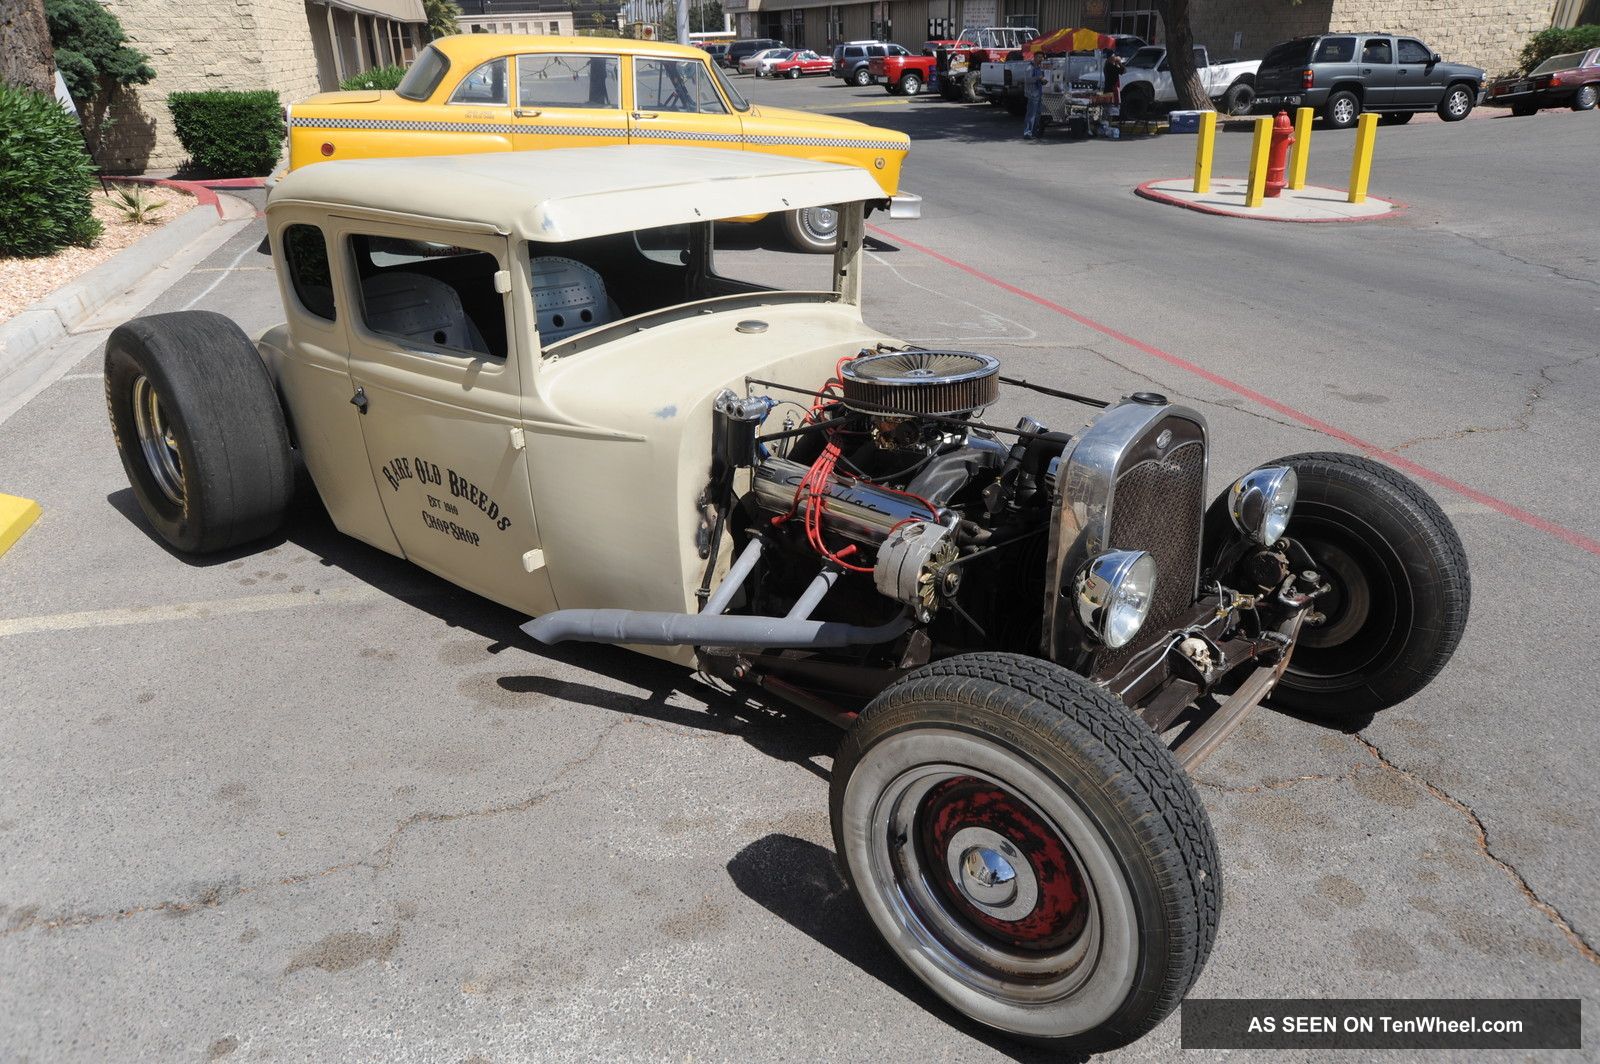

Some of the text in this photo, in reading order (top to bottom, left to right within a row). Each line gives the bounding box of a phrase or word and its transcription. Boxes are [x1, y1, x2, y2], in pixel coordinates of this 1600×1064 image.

[382, 456, 512, 531] RARE OLD BREEDS
